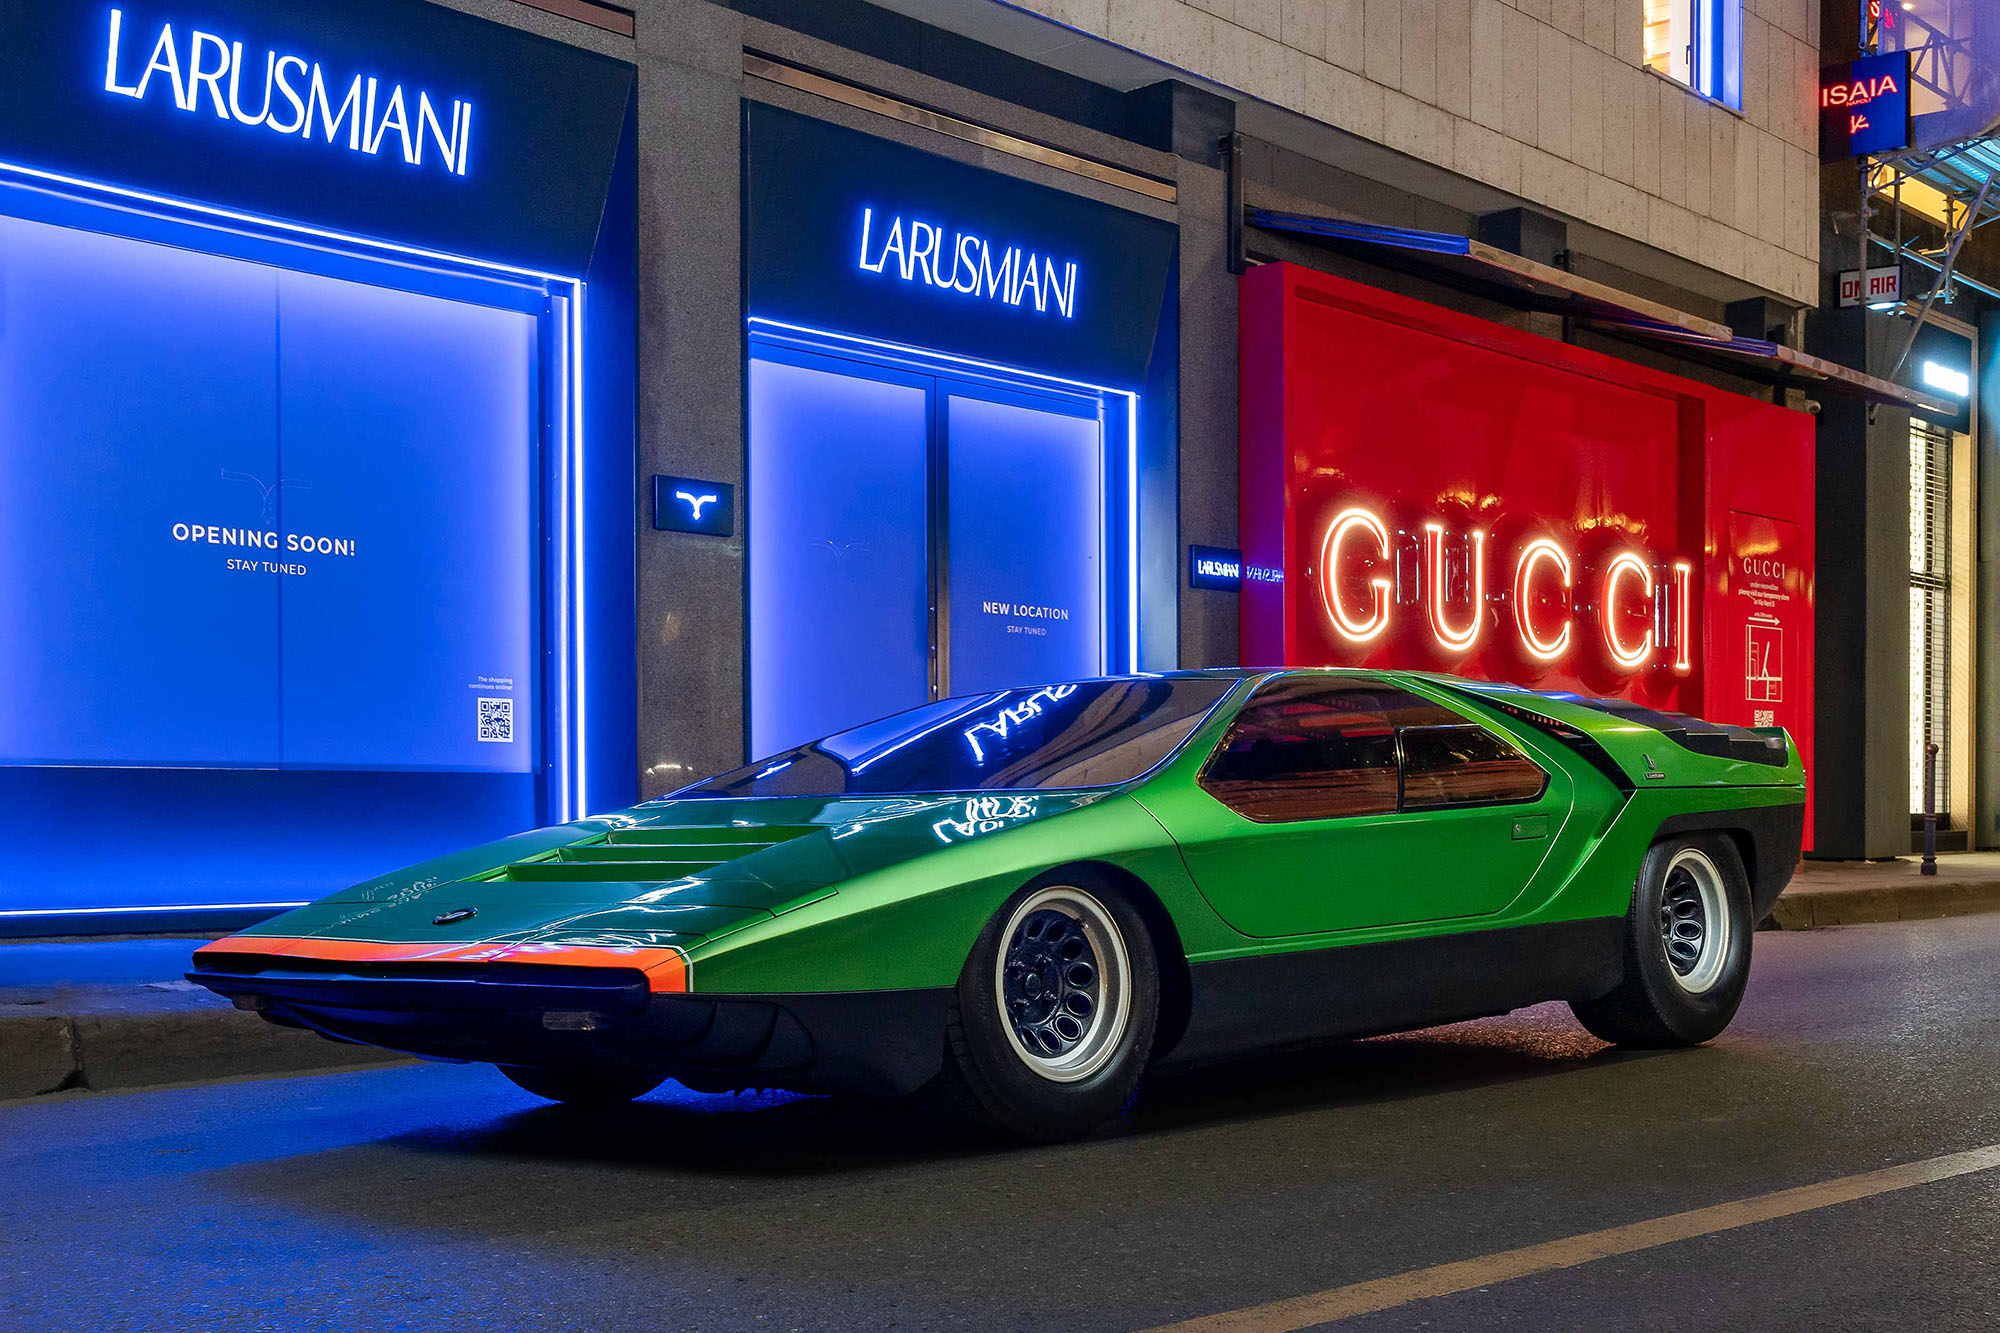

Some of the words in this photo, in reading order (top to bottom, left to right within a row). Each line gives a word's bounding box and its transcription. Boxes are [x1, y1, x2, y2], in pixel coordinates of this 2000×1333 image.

[105, 9, 471, 176] LARUSMIANI
[1822, 74, 1898, 107] ISAIA
[1846, 97, 1872, 107] NAPOLI
[859, 208, 1077, 319] LARUSMIANI
[1870, 275, 1897, 295] AIR
[171, 522, 279, 549] OPENING
[286, 534, 356, 557] SOON!
[226, 558, 259, 572] STAY
[262, 561, 307, 576] TUNED
[1743, 557, 1786, 580] GUCCI
[1319, 508, 1691, 670] GUCCI
[983, 601, 1010, 615] NEW
[1013, 604, 1069, 620] LOCATION
[1006, 625, 1022, 634] STAY
[1024, 626, 1047, 636] TUNED
